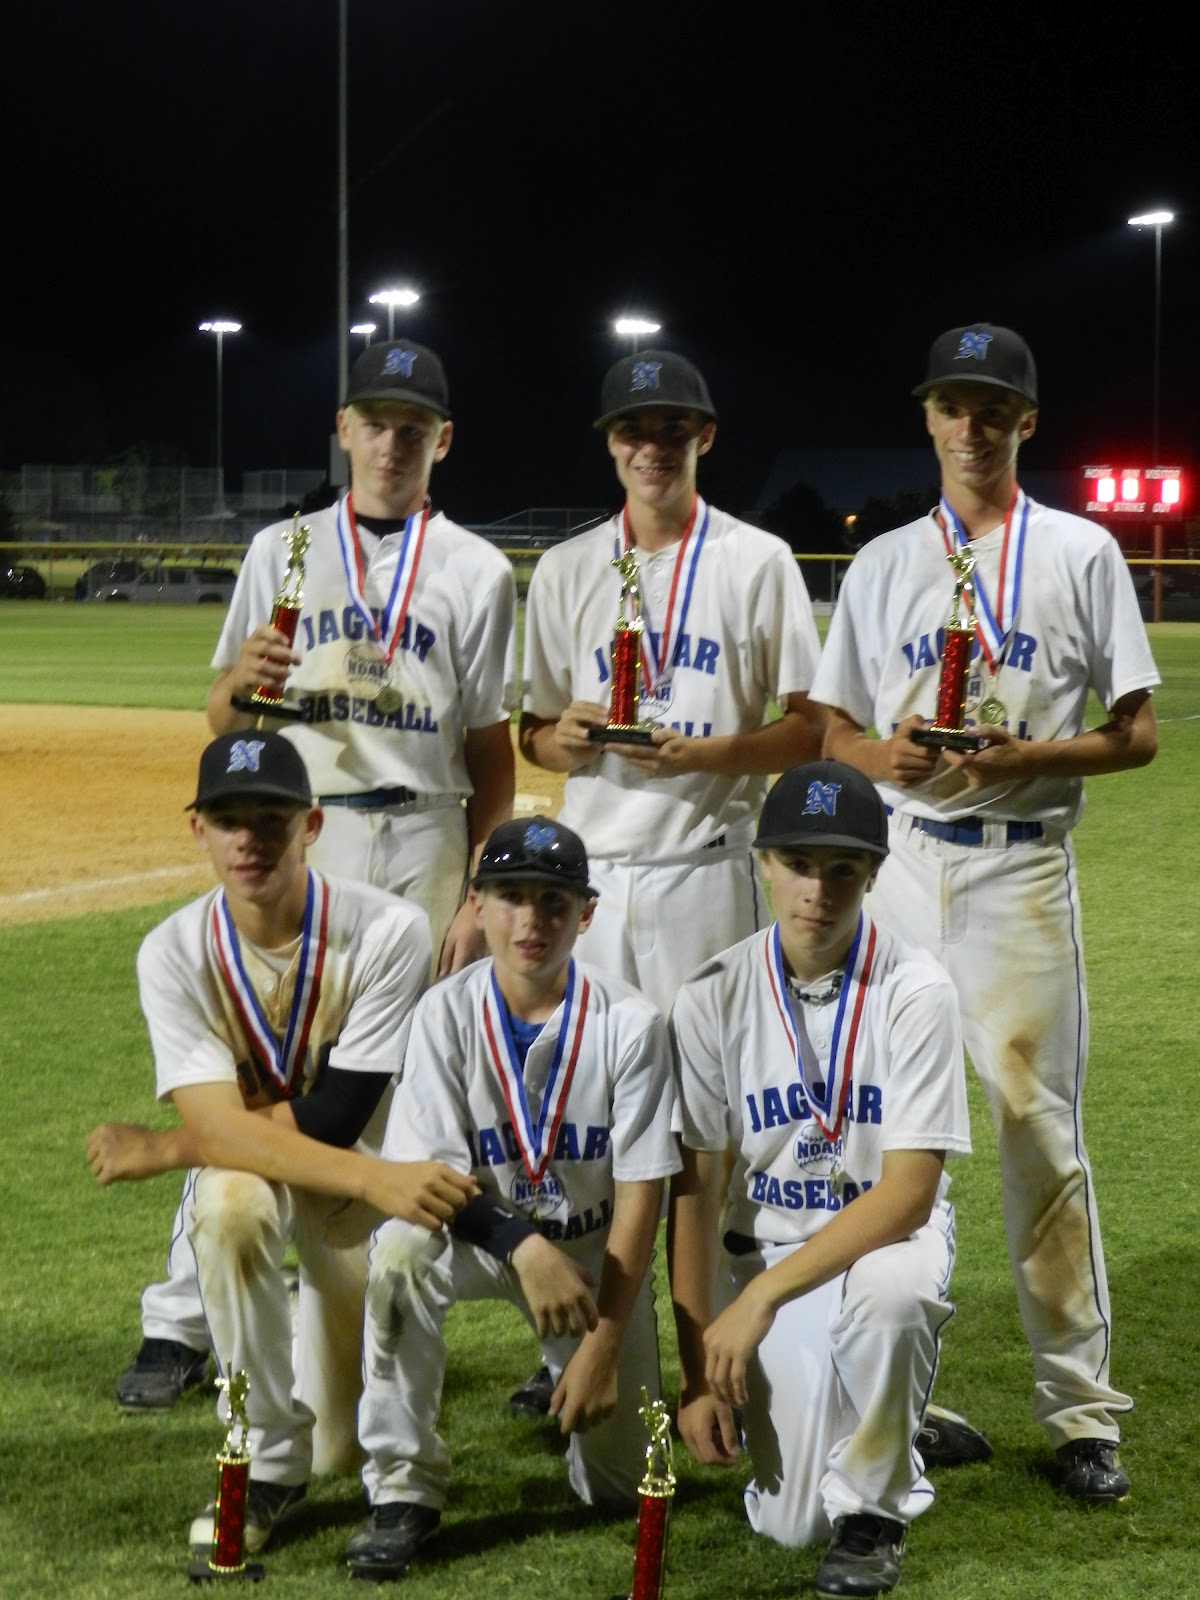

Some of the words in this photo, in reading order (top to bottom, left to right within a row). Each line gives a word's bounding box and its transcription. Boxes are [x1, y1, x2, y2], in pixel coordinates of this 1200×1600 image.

[1084, 468, 1113, 478] HOME
[1086, 501, 1109, 512] BALL
[1112, 502, 1146, 512] STRIKE
[1152, 503, 1171, 513] OUT
[797, 1140, 842, 1159] NOAH
